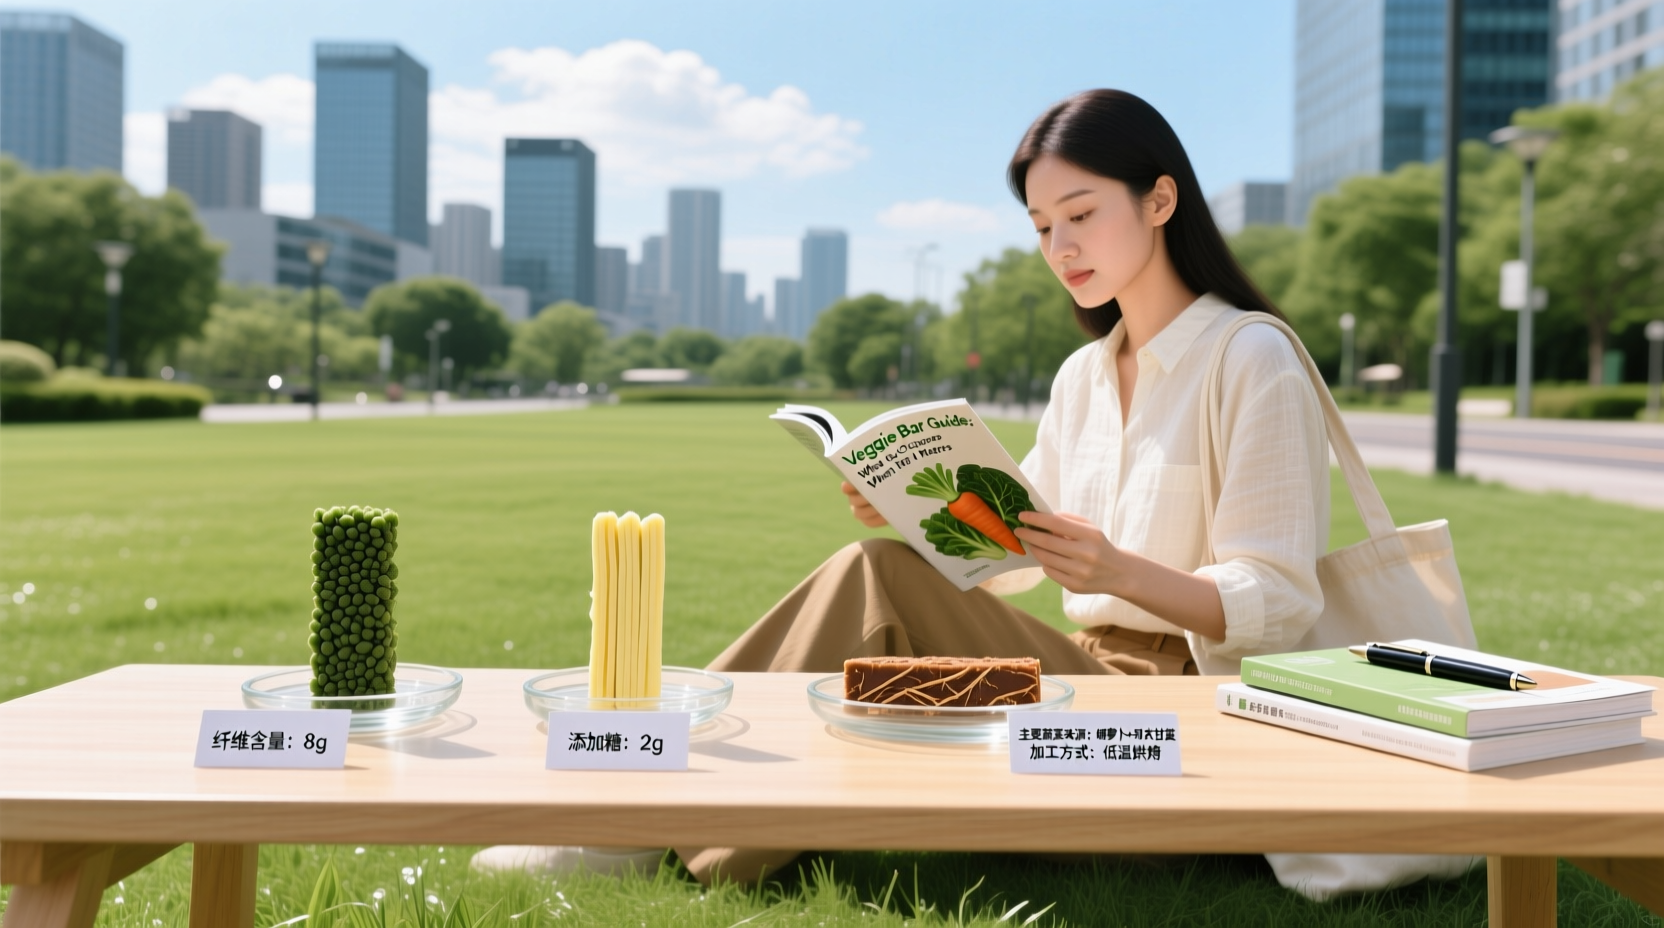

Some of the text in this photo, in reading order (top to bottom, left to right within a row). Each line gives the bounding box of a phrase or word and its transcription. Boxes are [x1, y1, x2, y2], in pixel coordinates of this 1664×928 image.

[842, 432, 897, 466] Veggie
[896, 422, 924, 439] Bar
[926, 415, 974, 429] Guide:
